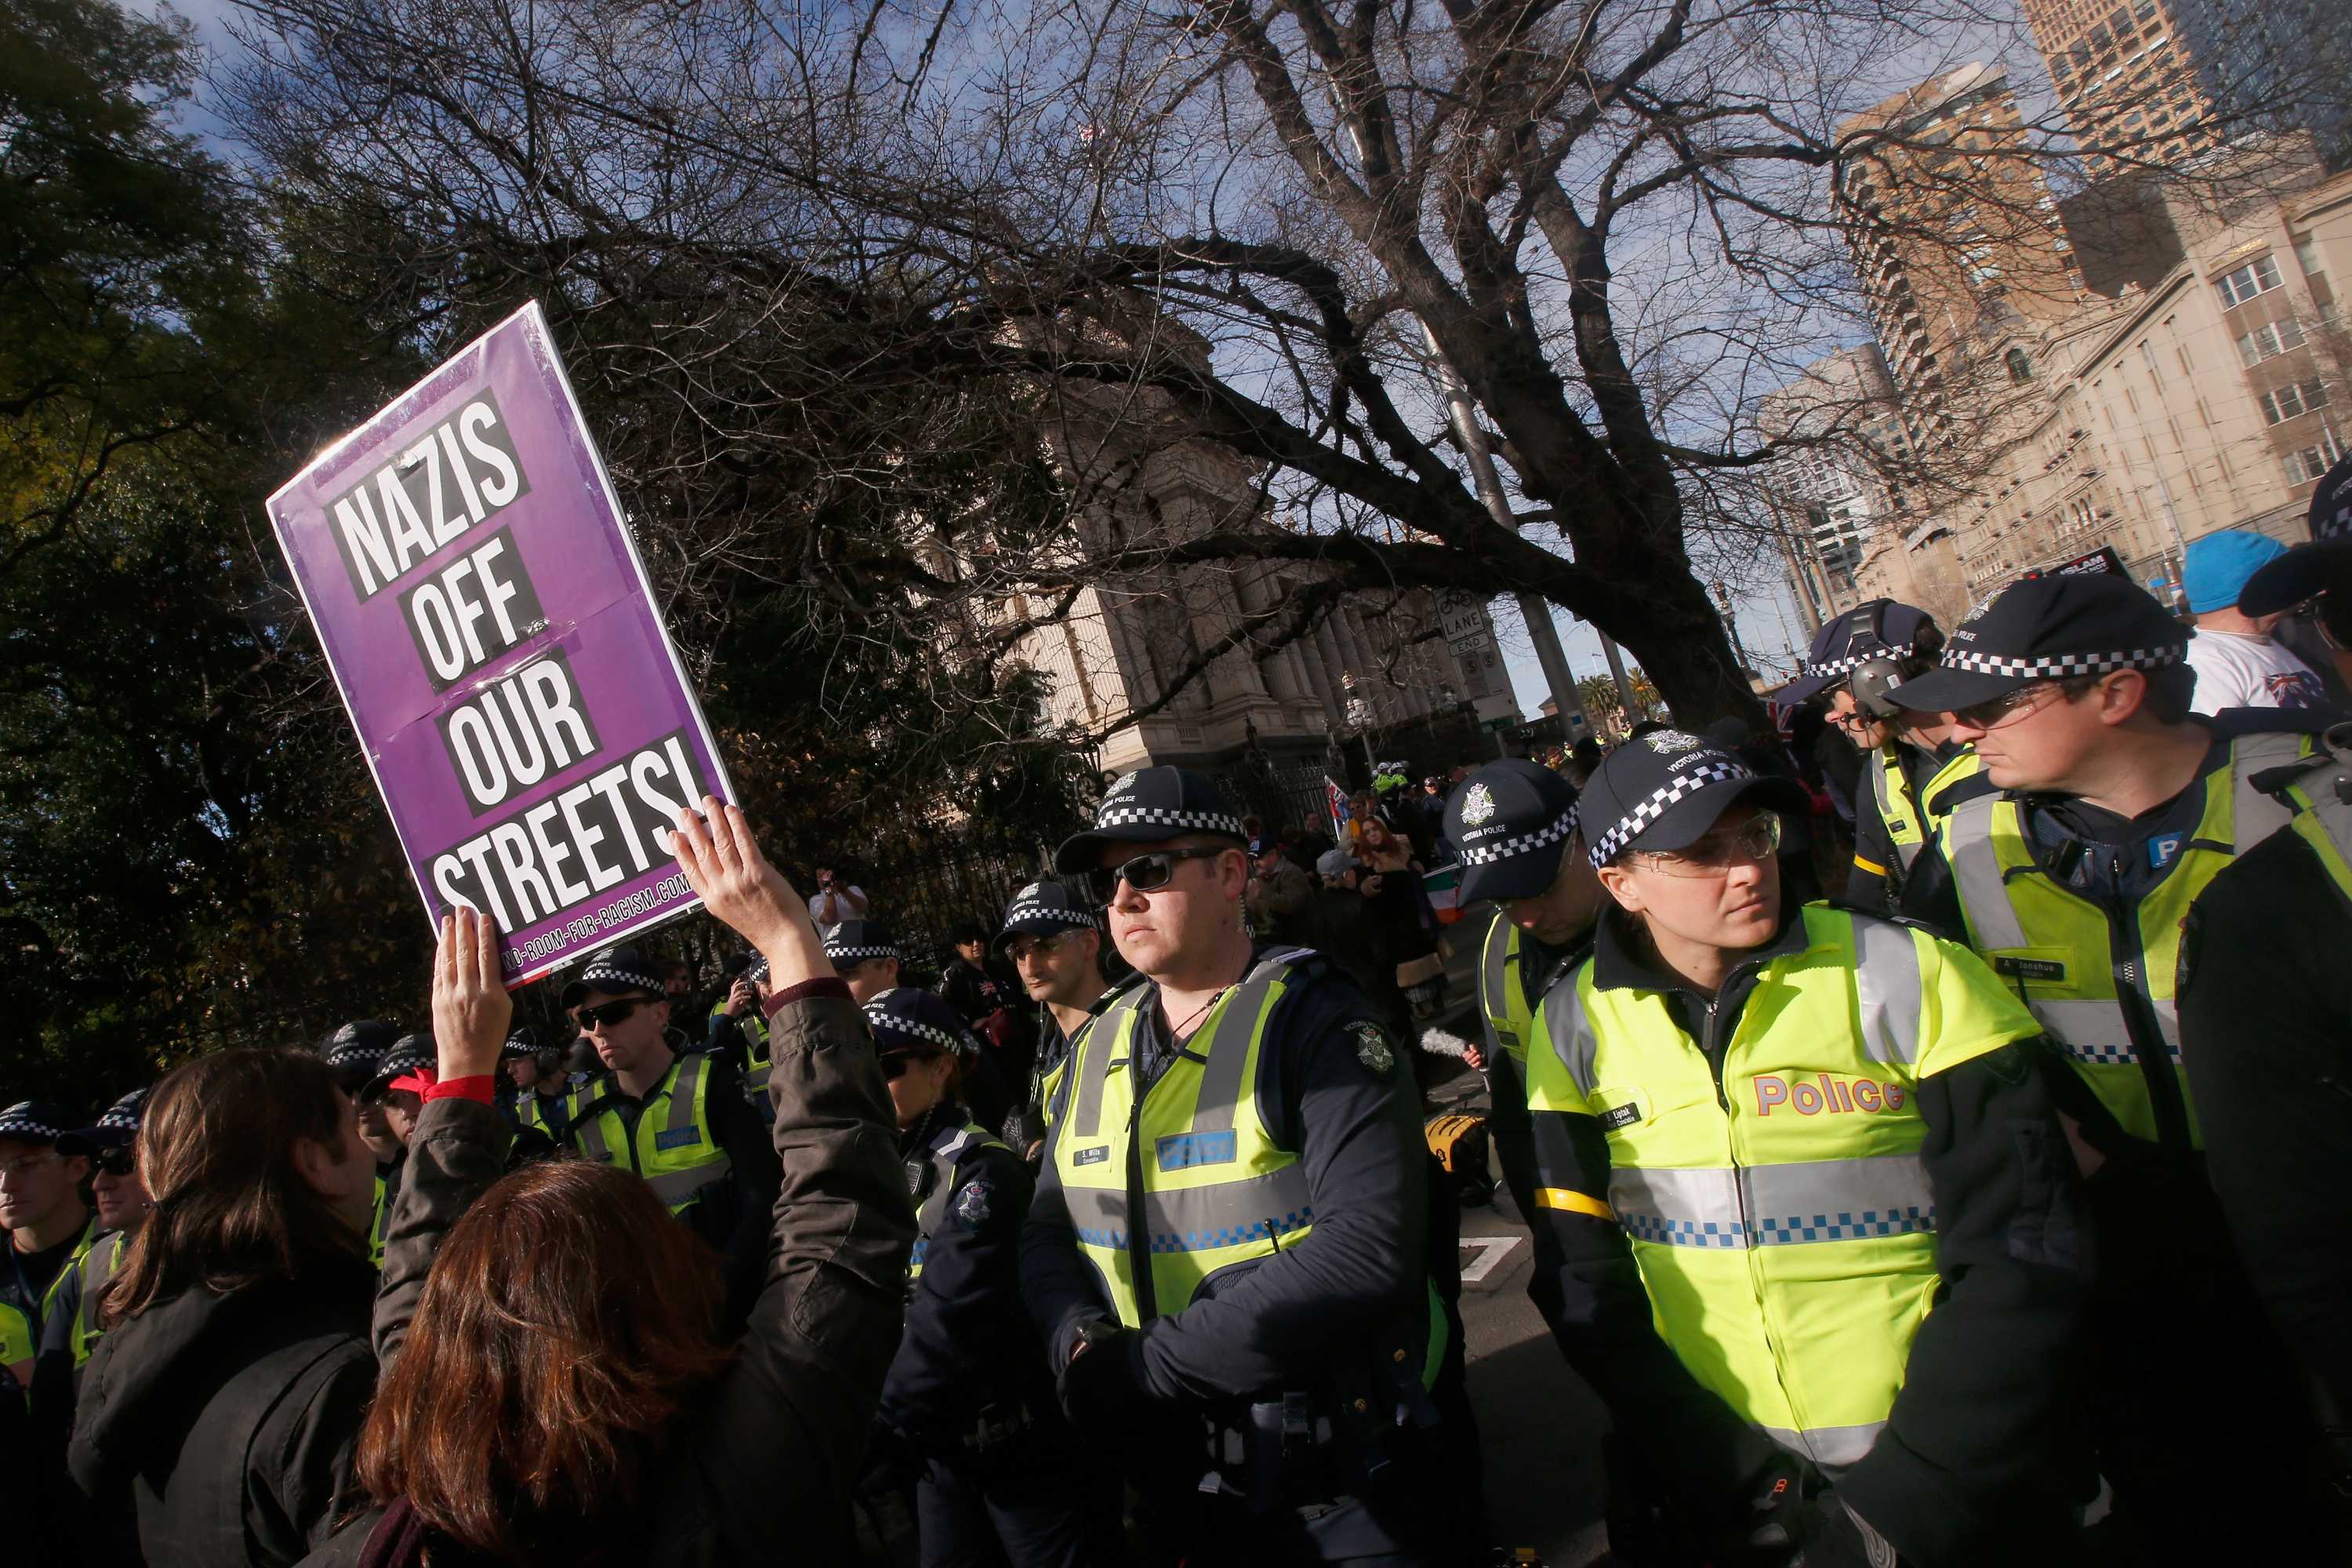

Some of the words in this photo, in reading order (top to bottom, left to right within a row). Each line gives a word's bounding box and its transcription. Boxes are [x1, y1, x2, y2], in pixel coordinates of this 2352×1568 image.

[333, 401, 519, 596] NAZIS
[412, 537, 517, 681] OFF
[1445, 612, 1480, 635] LANE
[1457, 637, 1479, 652] END
[449, 659, 596, 805] OUR
[1667, 751, 1705, 773] VICTORIA
[1114, 795, 1136, 804] POLICE
[433, 739, 706, 935] STREETS!
[1461, 829, 1483, 842] VICTORIA
[1483, 824, 1506, 836] POLICE
[503, 871, 692, 972] NO-ROOM-FOR-RACISM.COM
[1753, 1073, 1906, 1116] Police
[1164, 1138, 1230, 1166] Police
